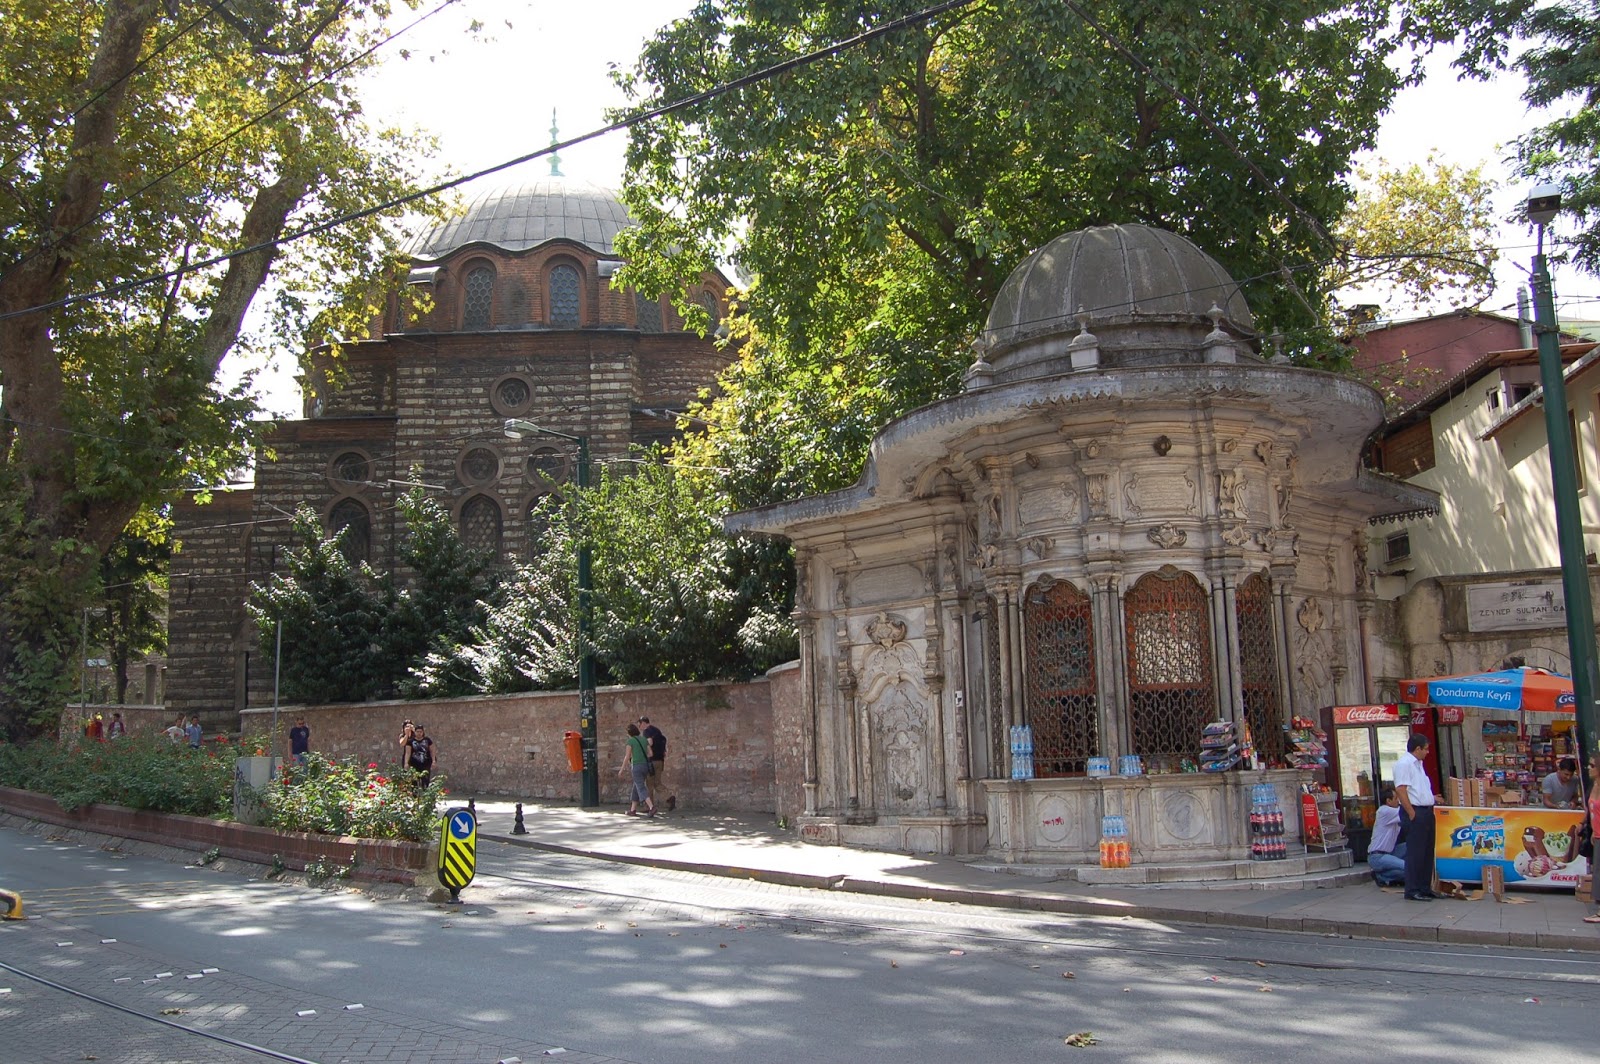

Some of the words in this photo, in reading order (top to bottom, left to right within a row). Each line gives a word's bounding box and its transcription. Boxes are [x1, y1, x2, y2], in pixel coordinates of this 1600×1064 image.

[1480, 608, 1511, 617] ZEYNEP
[1516, 606, 1547, 615] SULTAN
[1436, 687, 1484, 698] Dondurma
[1487, 689, 1512, 702] Keyfi
[1346, 705, 1393, 721] Coca-Cola
